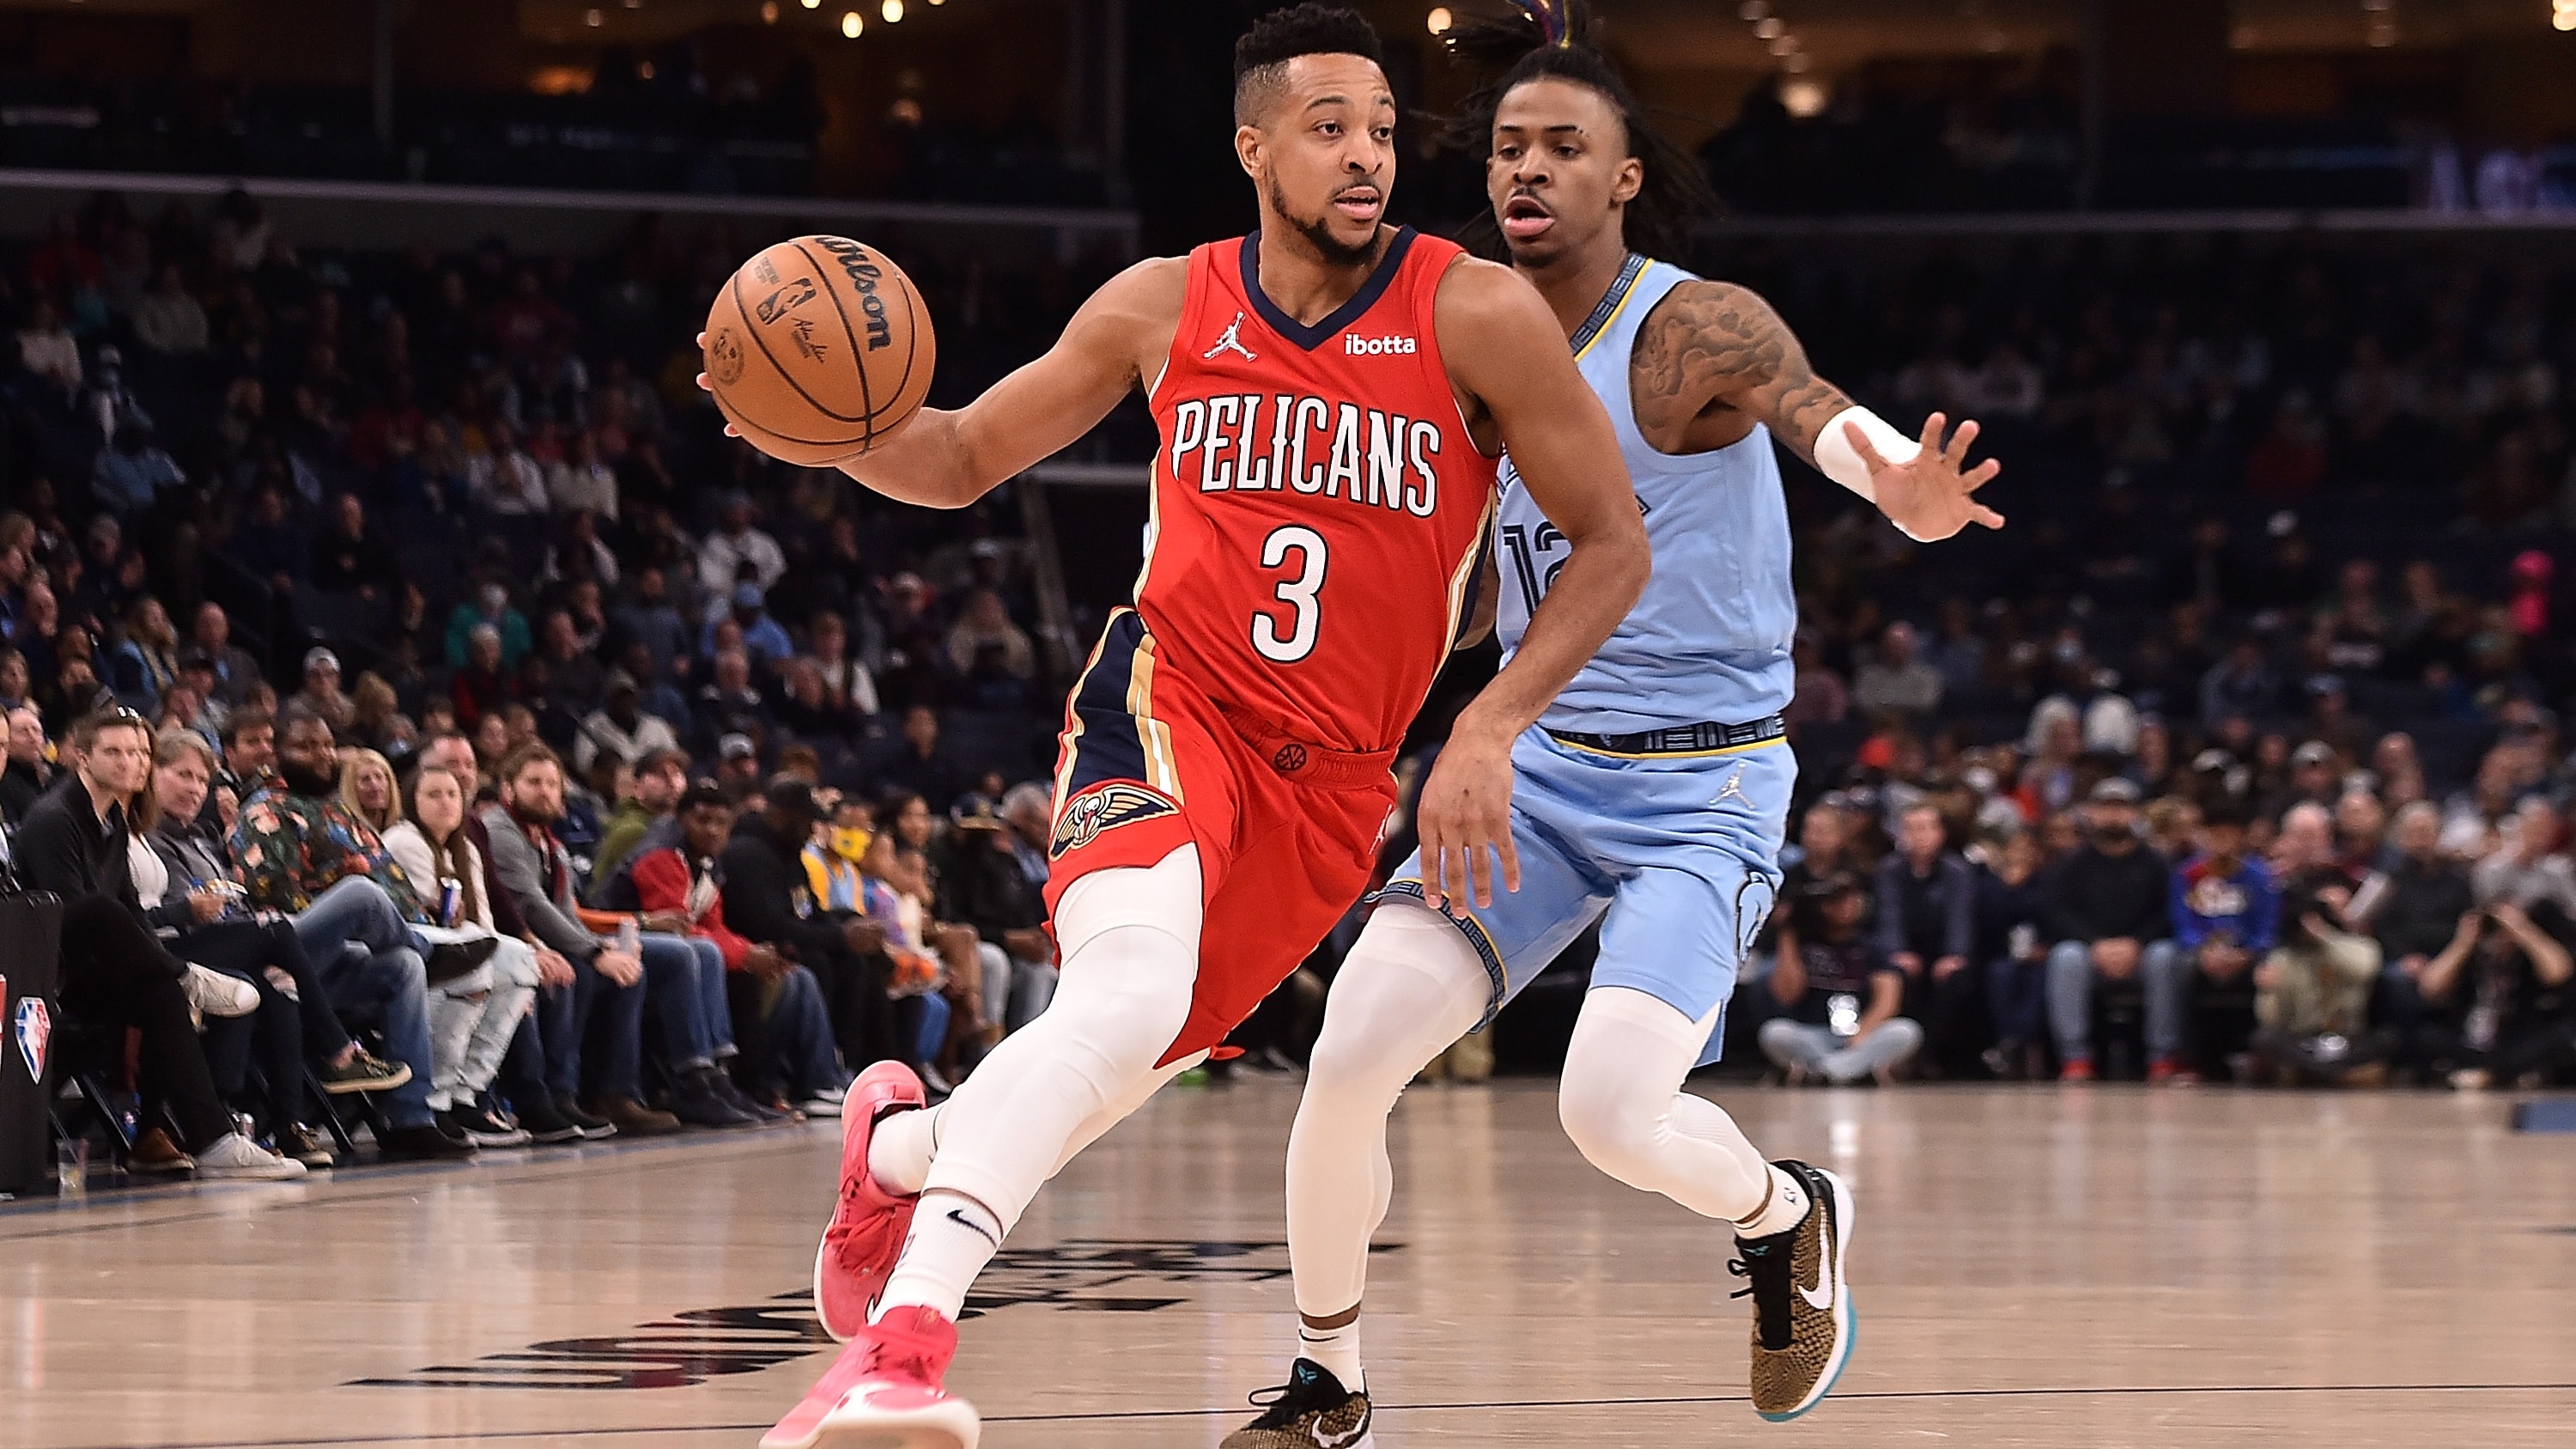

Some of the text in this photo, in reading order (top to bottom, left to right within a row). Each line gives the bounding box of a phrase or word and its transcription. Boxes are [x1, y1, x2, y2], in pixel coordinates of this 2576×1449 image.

[1345, 332, 1416, 356] ibotta
[1170, 393, 1441, 517] PELICANS
[1252, 523, 1329, 663] 3
